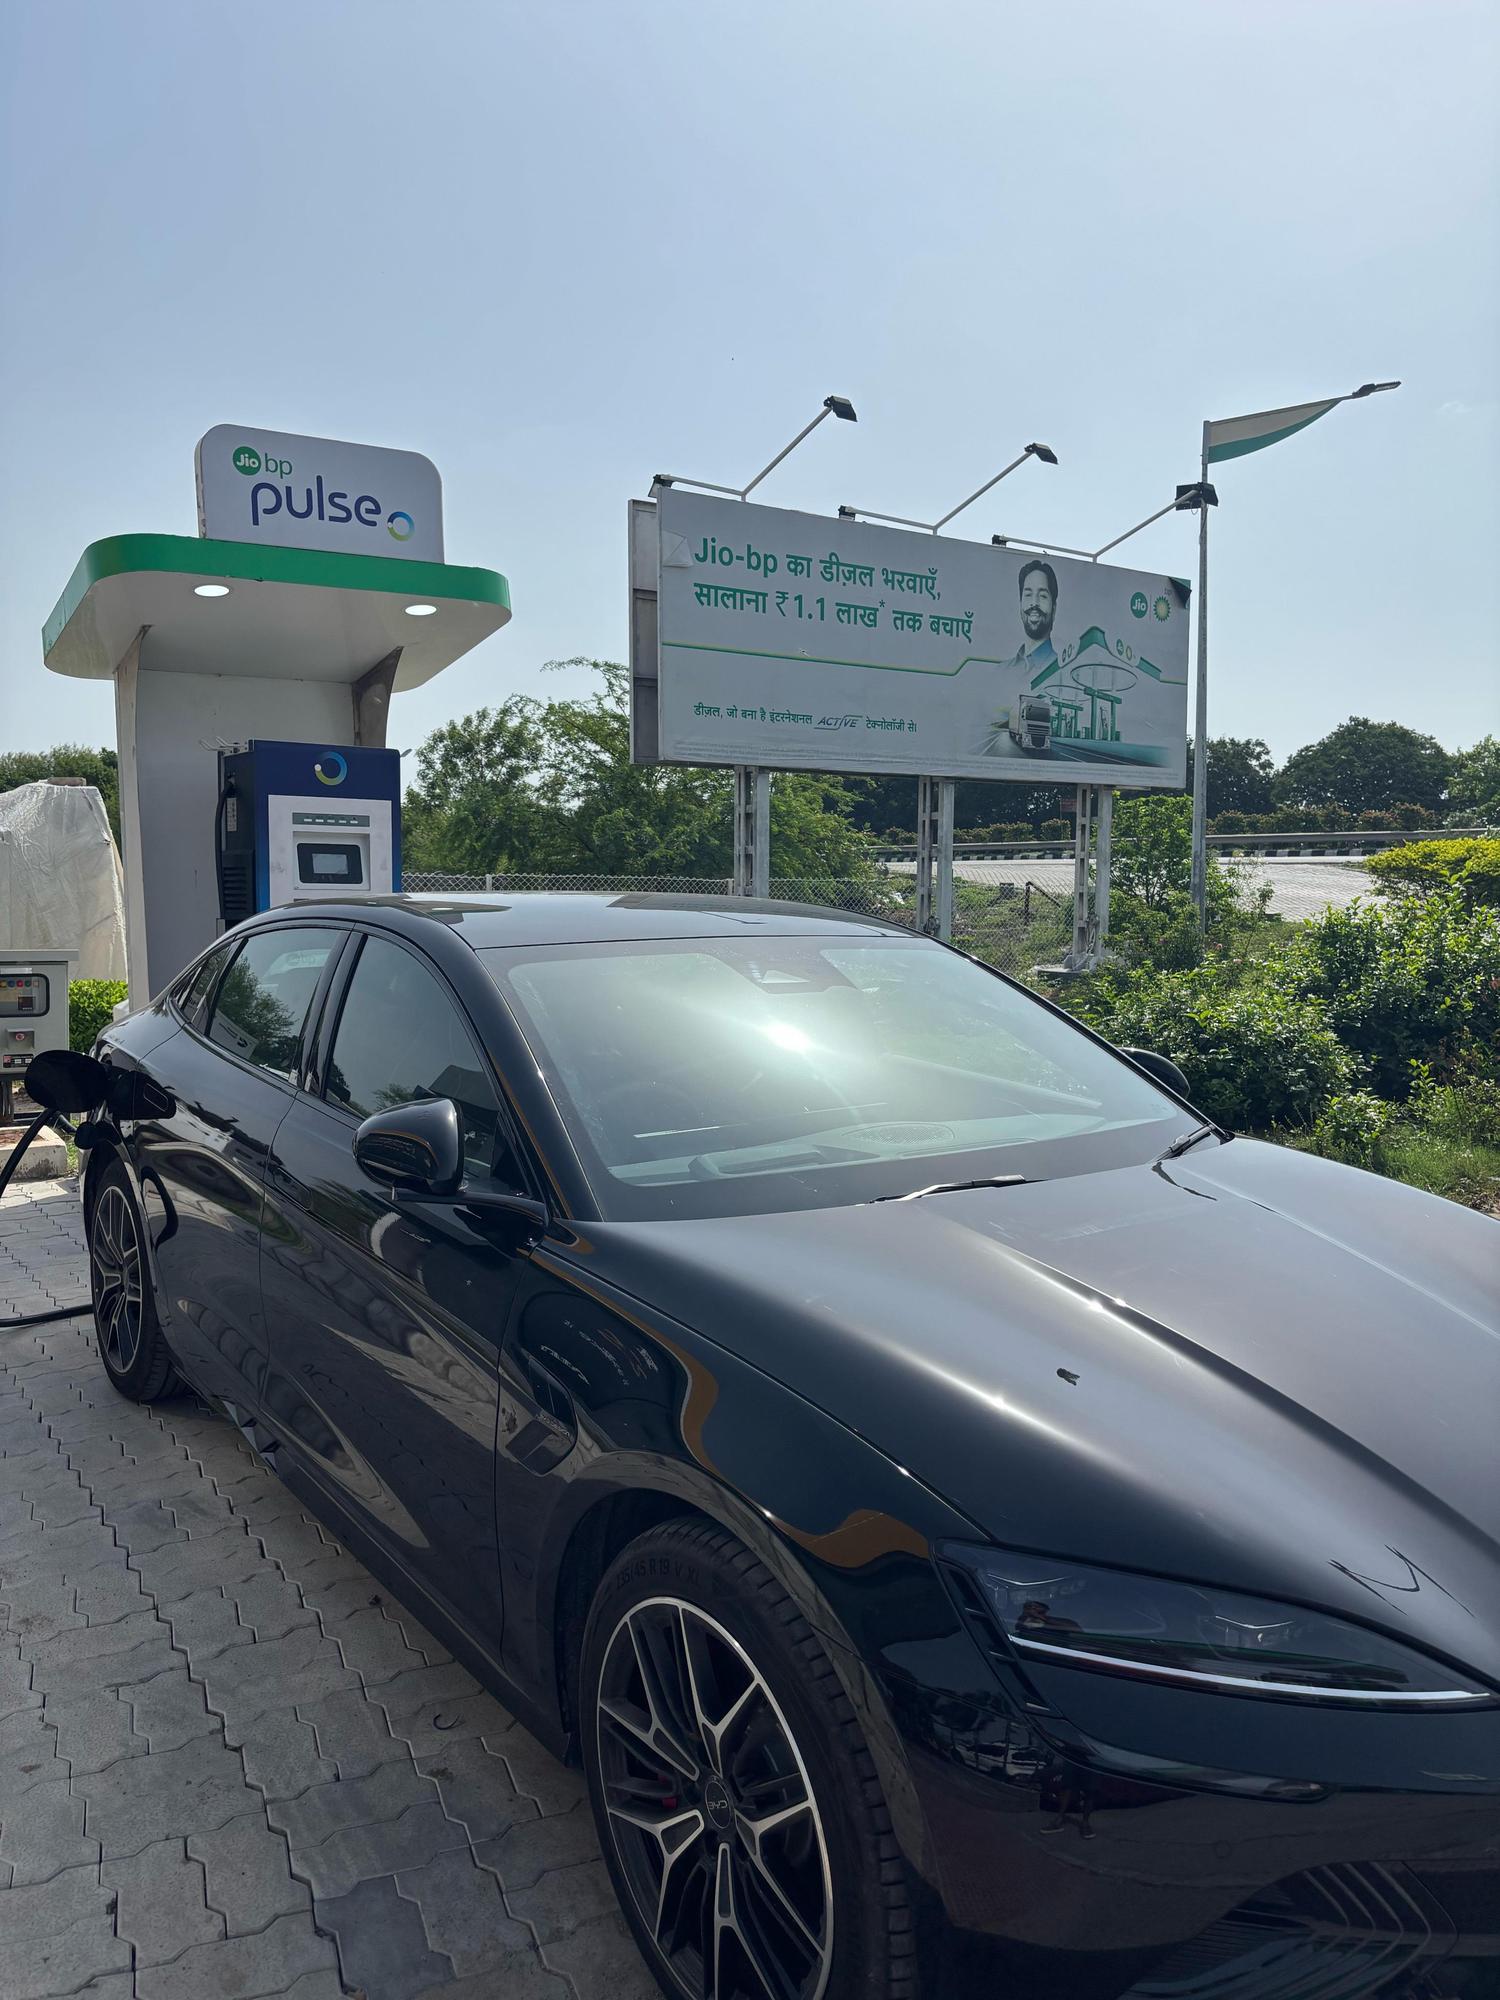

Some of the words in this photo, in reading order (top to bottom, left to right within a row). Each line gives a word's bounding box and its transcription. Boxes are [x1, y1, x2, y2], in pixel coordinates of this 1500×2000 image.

[236, 453, 259, 469] Jio
[264, 452, 293, 479] bp
[251, 474, 382, 527] pulse
[694, 537, 778, 577] Jio-bp
[786, 553, 813, 579] का
[819, 551, 876, 588] डीज़ल
[882, 566, 941, 601] भरवाएँ,
[693, 582, 769, 614] सालाना
[892, 608, 923, 633] तक
[929, 610, 975, 643] बचाएँ
[1132, 598, 1146, 611] Jio
[726, 704, 738, 719] जो
[741, 708, 757, 721] बना
[759, 706, 767, 722] है
[815, 715, 861, 730] ACTIVE
[707, 1800, 728, 1810] BYD
